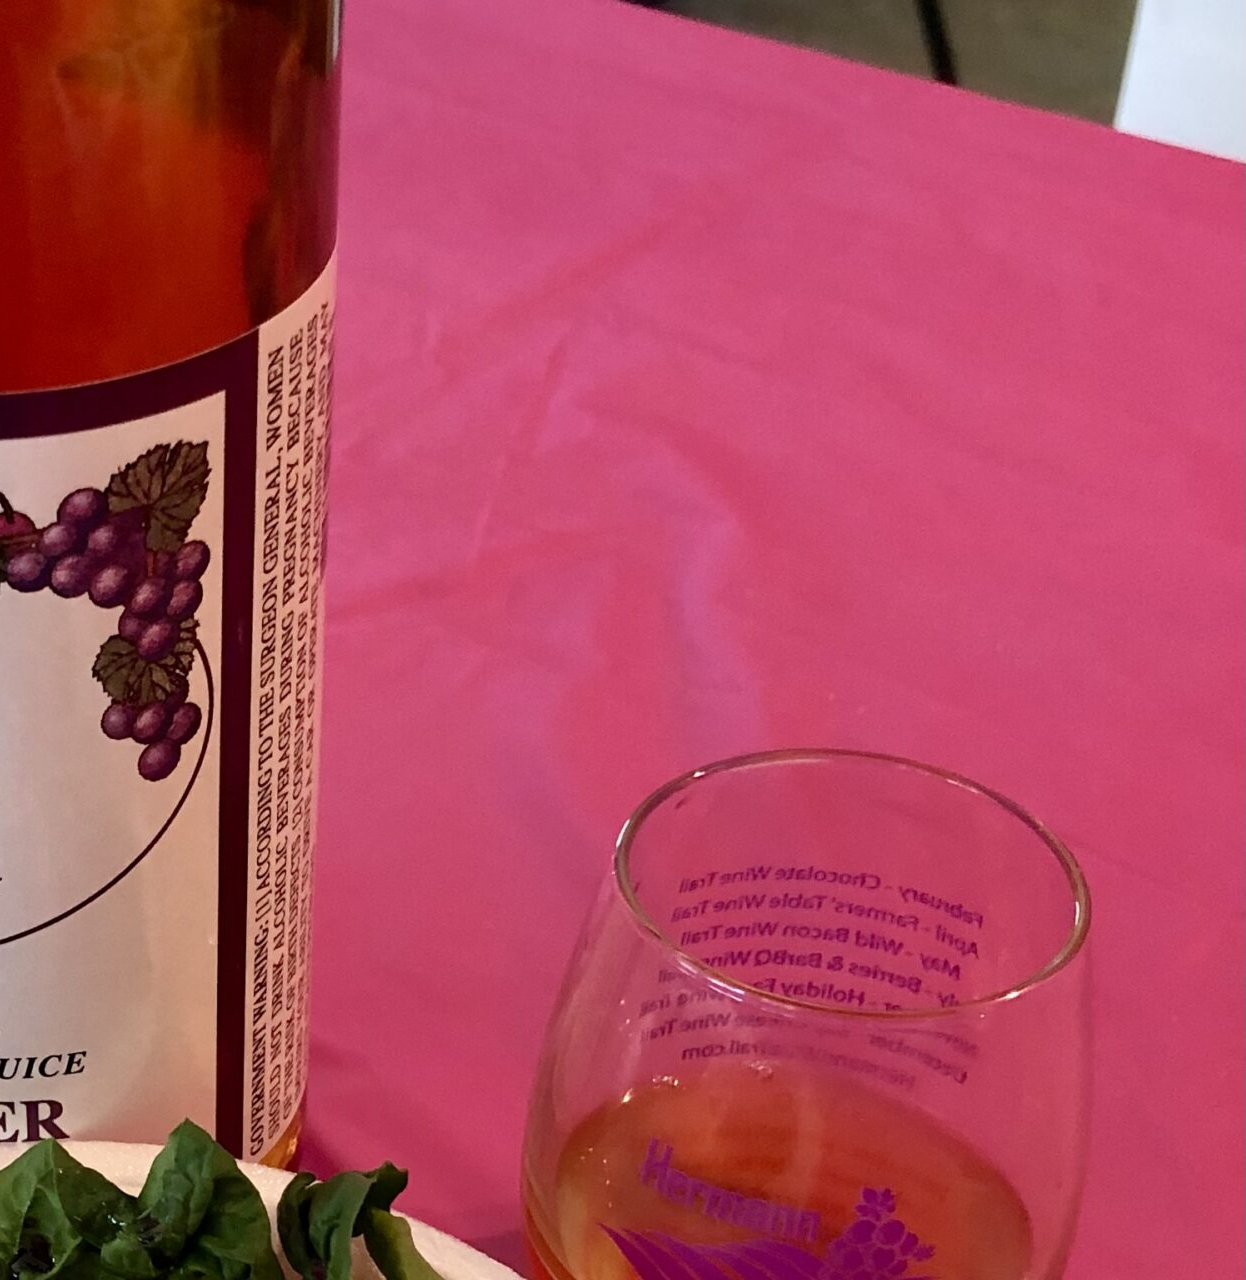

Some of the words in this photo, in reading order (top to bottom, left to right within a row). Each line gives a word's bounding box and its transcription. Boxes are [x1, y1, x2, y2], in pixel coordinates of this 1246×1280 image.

[266, 345, 284, 452] WOMEN
[286, 328, 303, 452] BECAUSE
[303, 314, 318, 468] BEVERAGES
[262, 447, 283, 574] GENERAL,
[282, 459, 299, 607] PREGNANCY
[298, 468, 313, 604] ALCOHOLIC
[260, 577, 278, 688] SURGEON
[279, 610, 294, 703] DURING
[297, 610, 307, 641] OF
[258, 687, 274, 737] THE
[258, 737, 273, 769] TO
[292, 644, 307, 800] CONSUMPTION
[276, 705, 291, 835] BEVERAGES
[256, 768, 272, 890] ACCORDING
[273, 836, 288, 949] ALCOHOLIC
[253, 920, 269, 1025] WARNING:
[271, 954, 284, 1018] DRINK
[286, 985, 295, 1010] OF
[287, 928, 298, 980] BIRTH
[250, 1025, 266, 1156] GOVERNMENT
[270, 1020, 283, 1057] NOT
[284, 1059, 293, 1096] THE
[268, 1064, 281, 1139] SHOULD
[640, 1137, 821, 1242] Hermann
